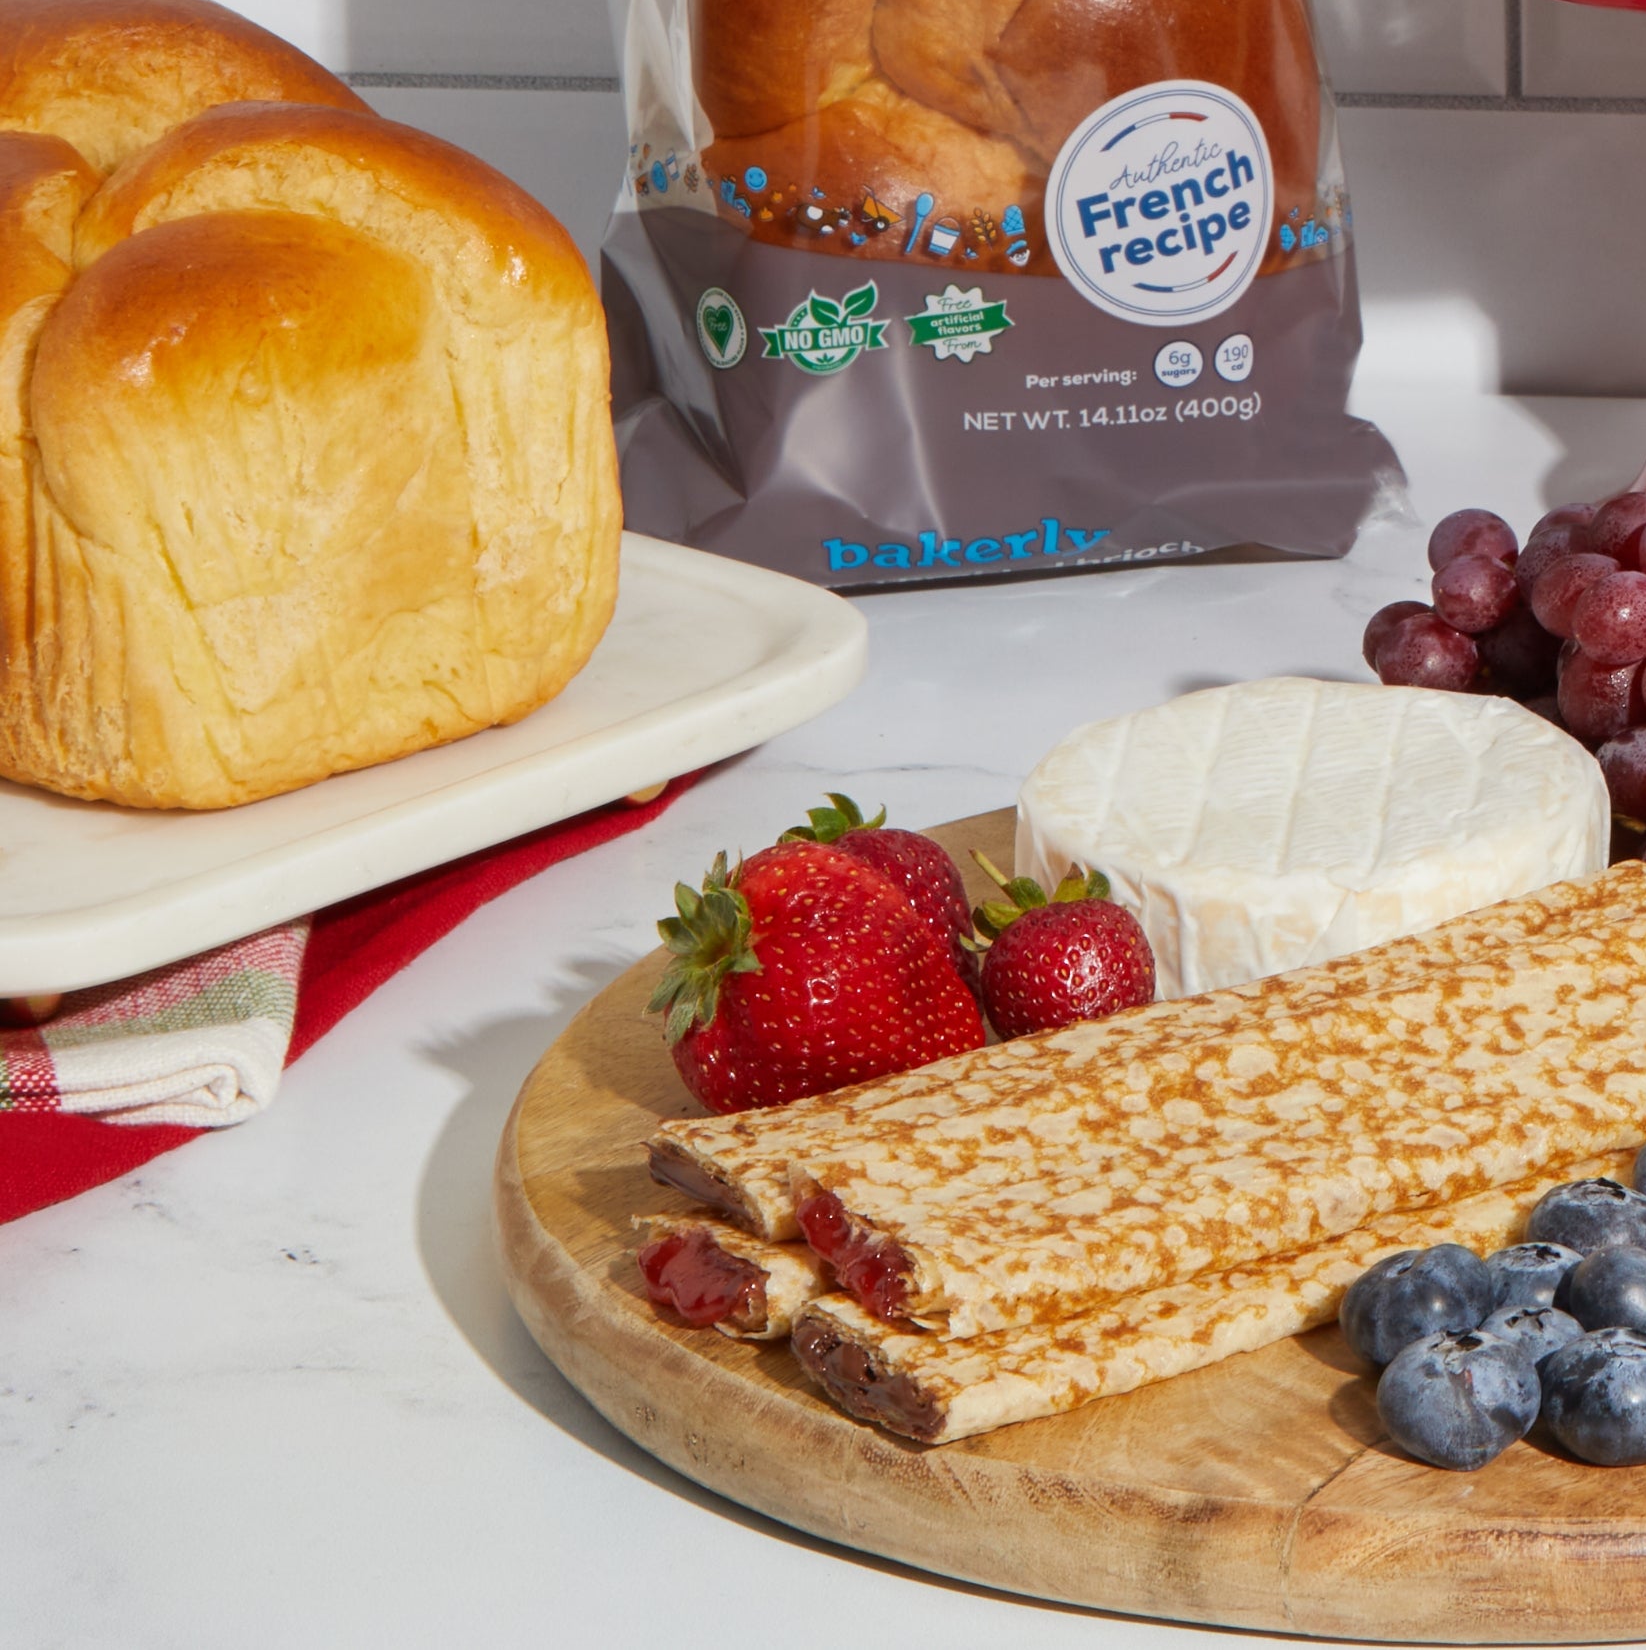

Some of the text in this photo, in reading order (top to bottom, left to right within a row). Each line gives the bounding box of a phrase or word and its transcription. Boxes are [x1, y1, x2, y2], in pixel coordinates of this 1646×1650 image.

[1110, 138, 1222, 190] Authentic
[1077, 149, 1254, 239] French
[1098, 200, 1251, 275] recipe
[938, 297, 972, 312] Free
[930, 312, 985, 327] artificial
[784, 326, 864, 350] NO GMO
[938, 323, 982, 336] flavors
[943, 338, 982, 351] From
[1223, 344, 1249, 363] 190
[1168, 351, 1192, 366] 6g
[1026, 369, 1137, 389] Per serving:
[1161, 366, 1197, 378] sugars
[963, 391, 1262, 431] NET WT. 14.11oz (400g)
